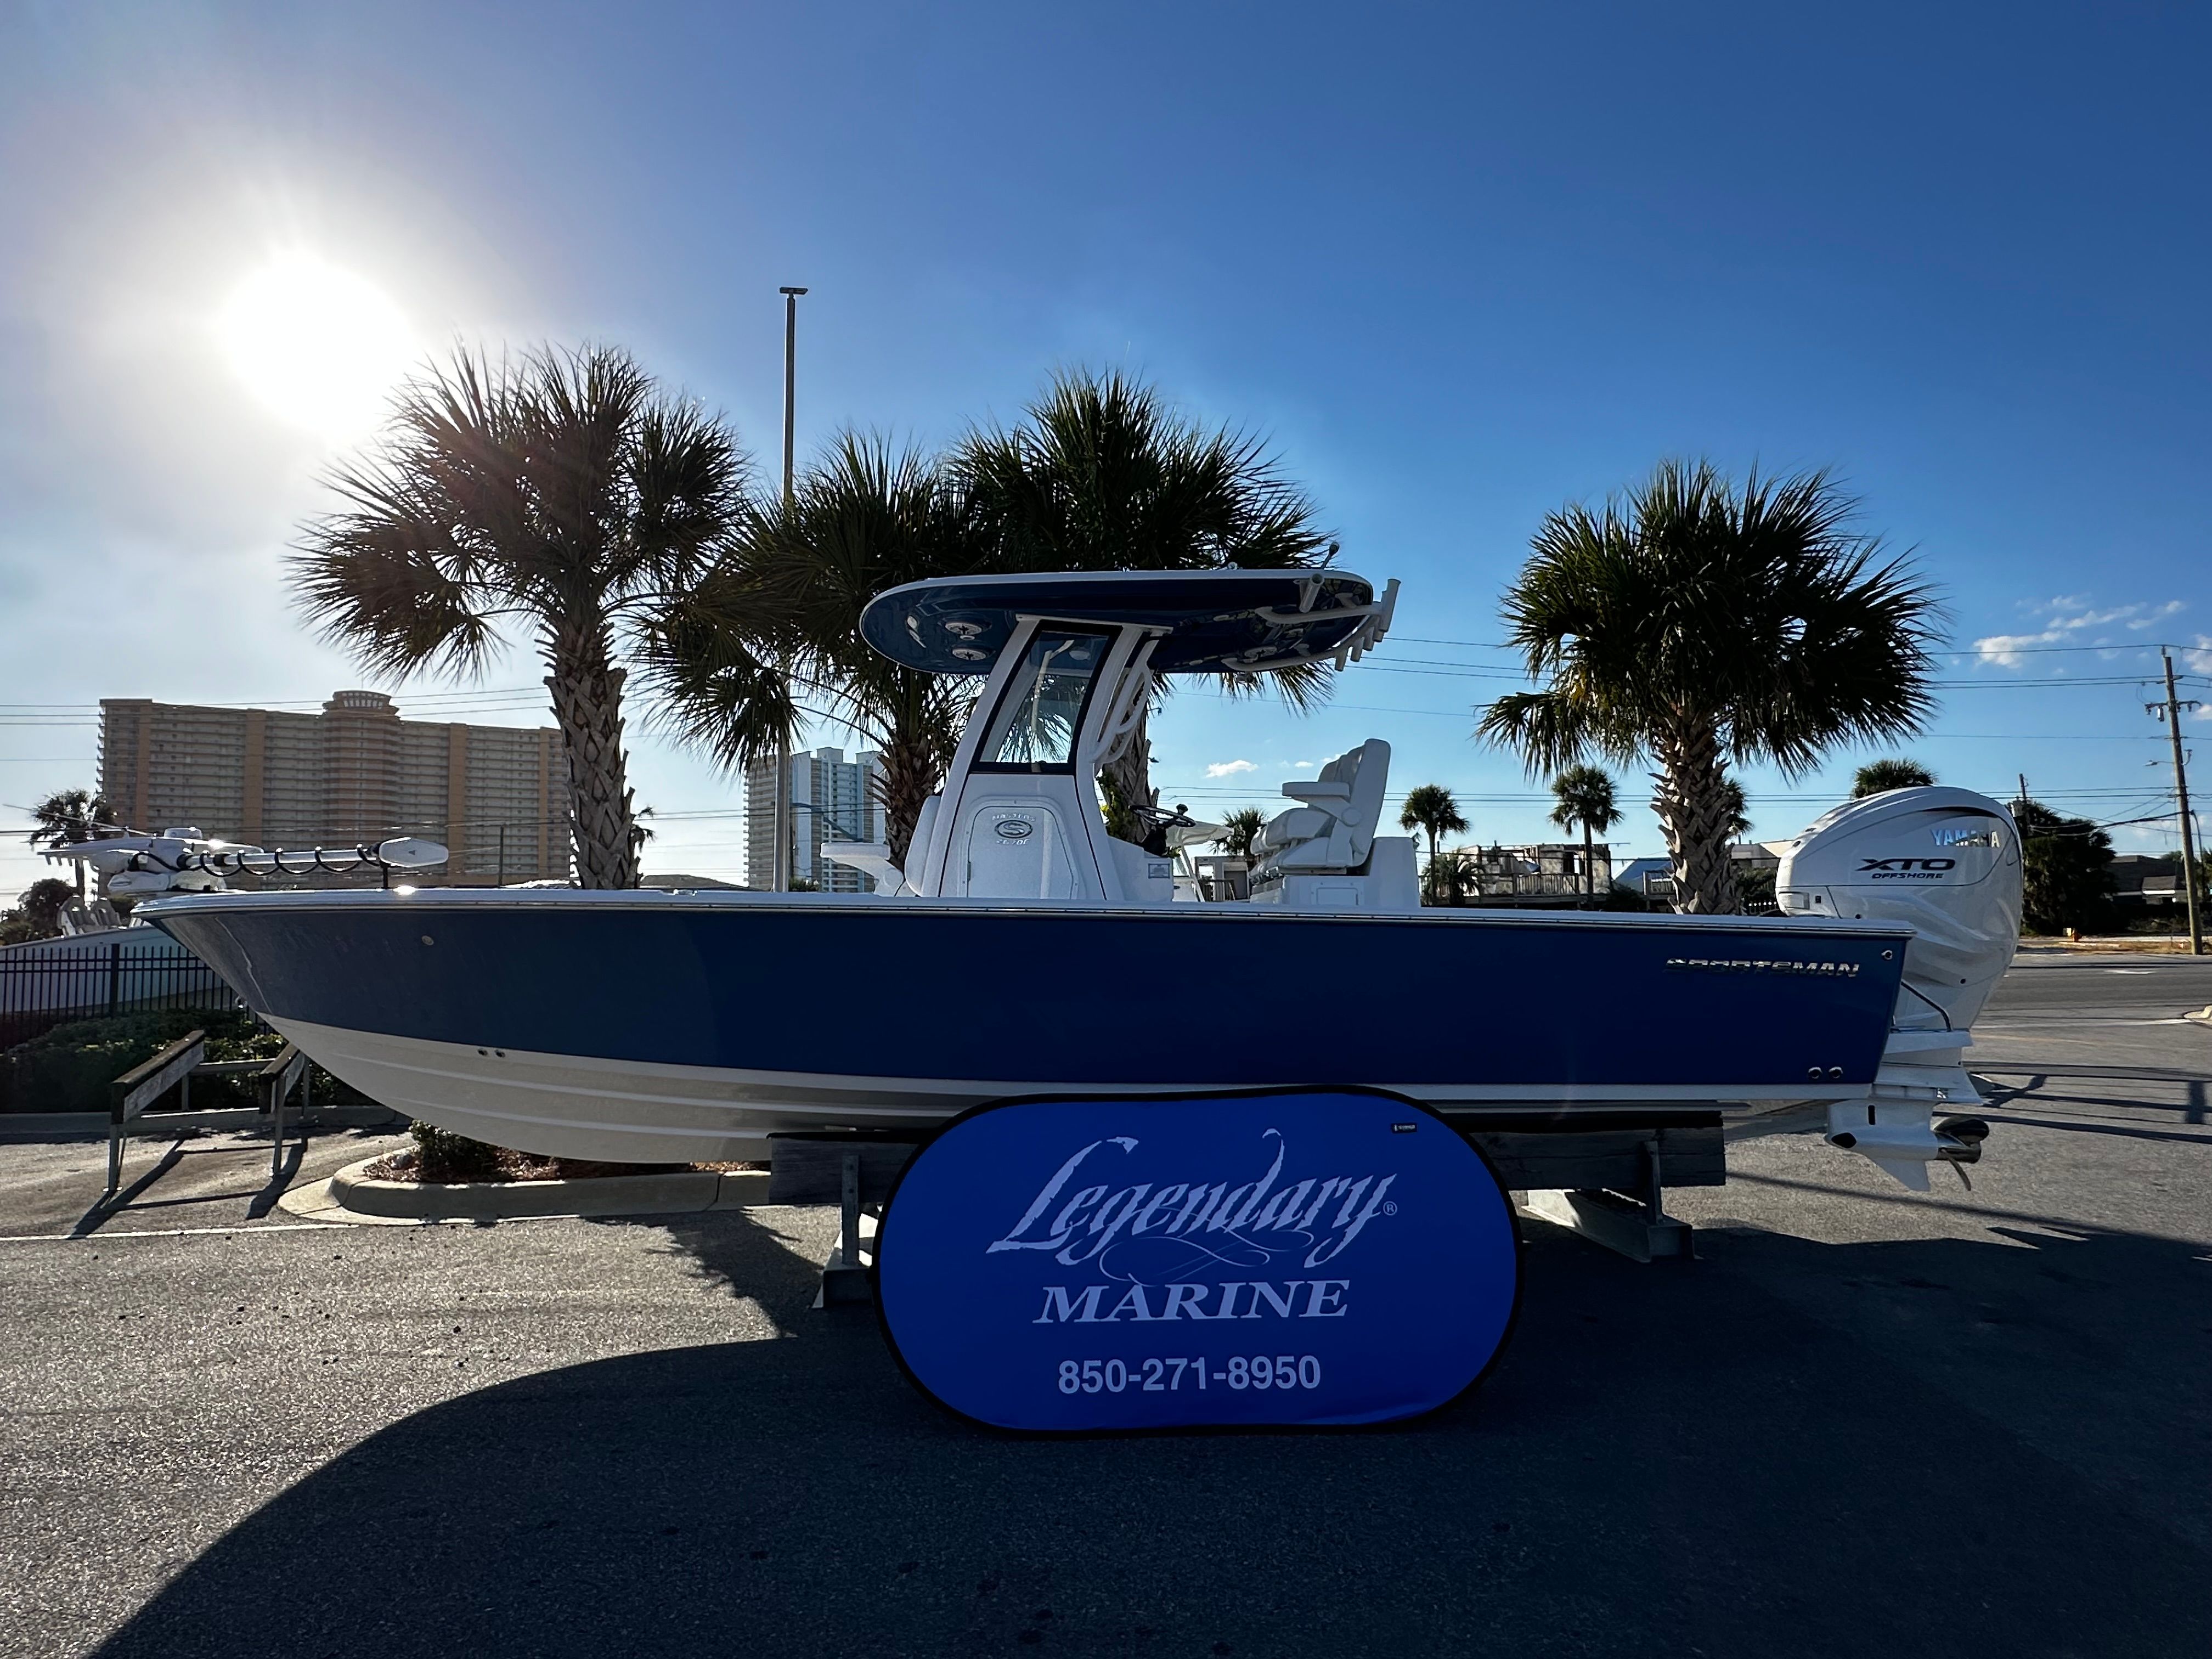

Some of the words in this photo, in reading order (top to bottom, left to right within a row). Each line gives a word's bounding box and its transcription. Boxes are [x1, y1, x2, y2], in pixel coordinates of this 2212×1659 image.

[1854, 858, 1956, 871] XTO
[1032, 1279, 1350, 1324] MARINE
[1058, 1355, 1322, 1395] 850-271-8950
